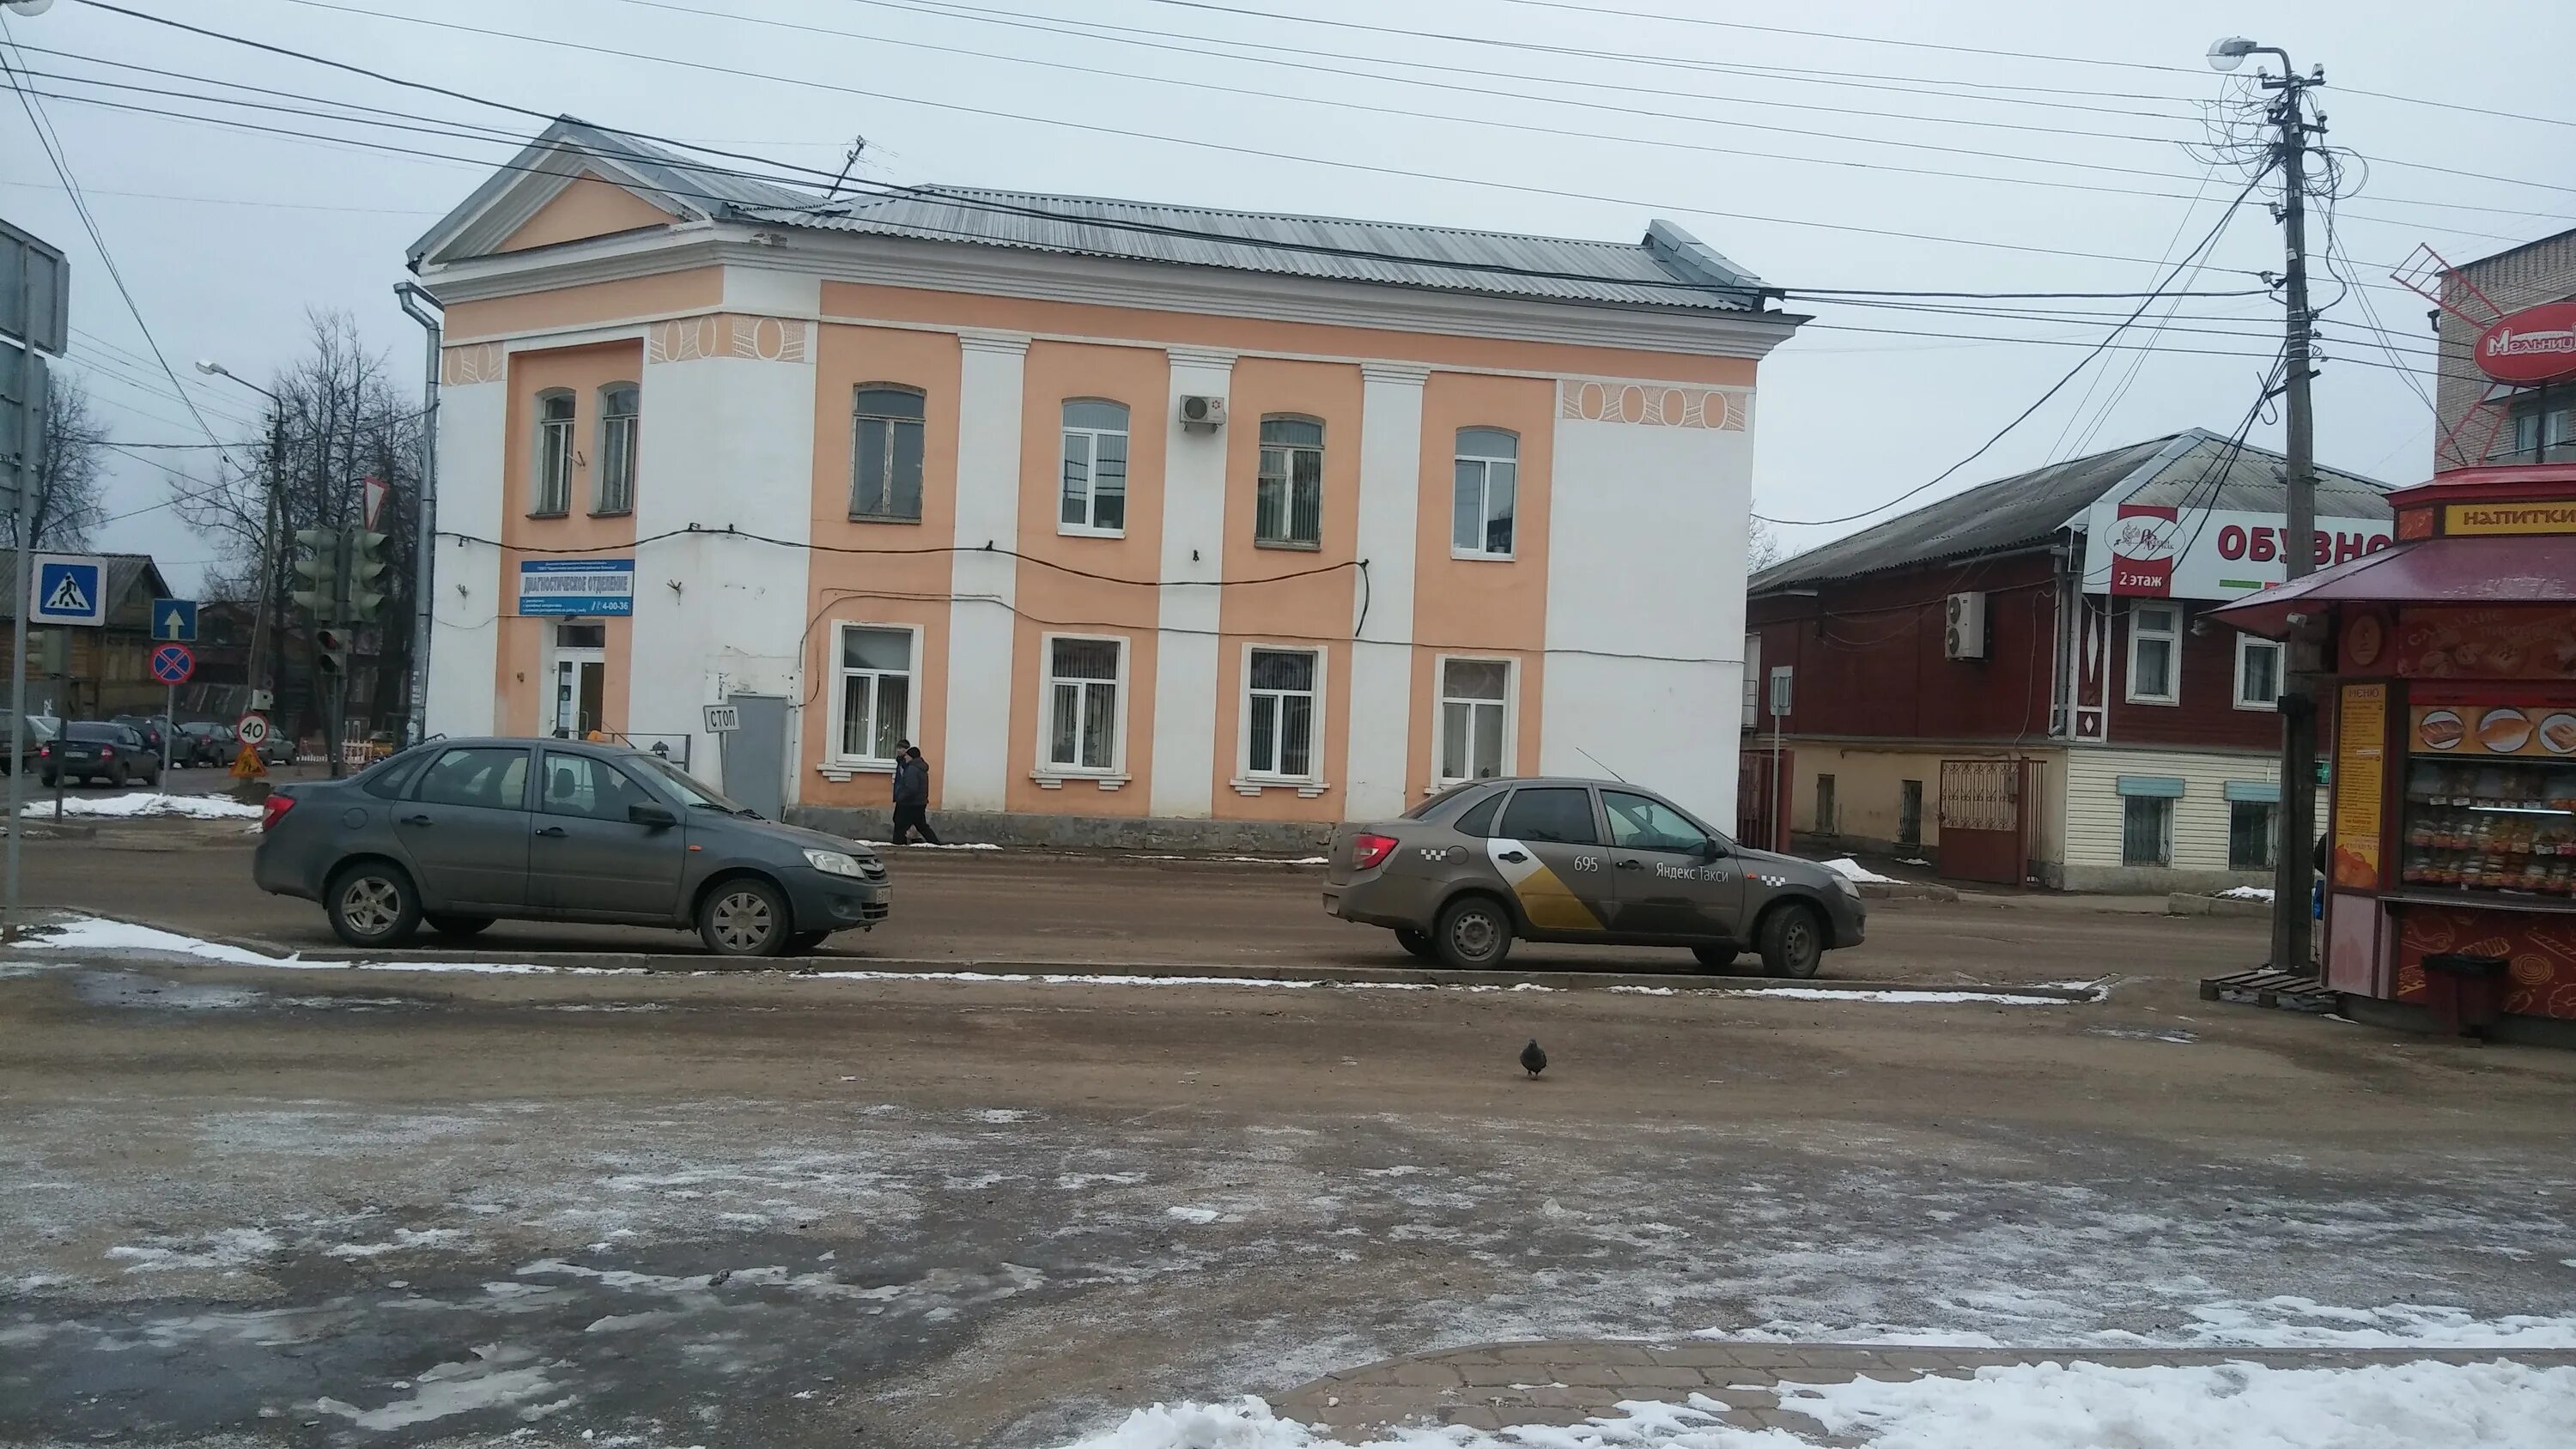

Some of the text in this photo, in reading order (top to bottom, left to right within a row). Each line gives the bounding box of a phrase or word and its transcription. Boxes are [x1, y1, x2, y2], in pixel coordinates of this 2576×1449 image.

[2487, 322, 2576, 356] Мельниц
[2118, 571, 2162, 587] 2 этаж
[710, 709, 736, 727] СТОП
[241, 722, 264, 738] 40
[1574, 855, 1598, 872] 695
[1656, 862, 1729, 882] Яндекс Такси
